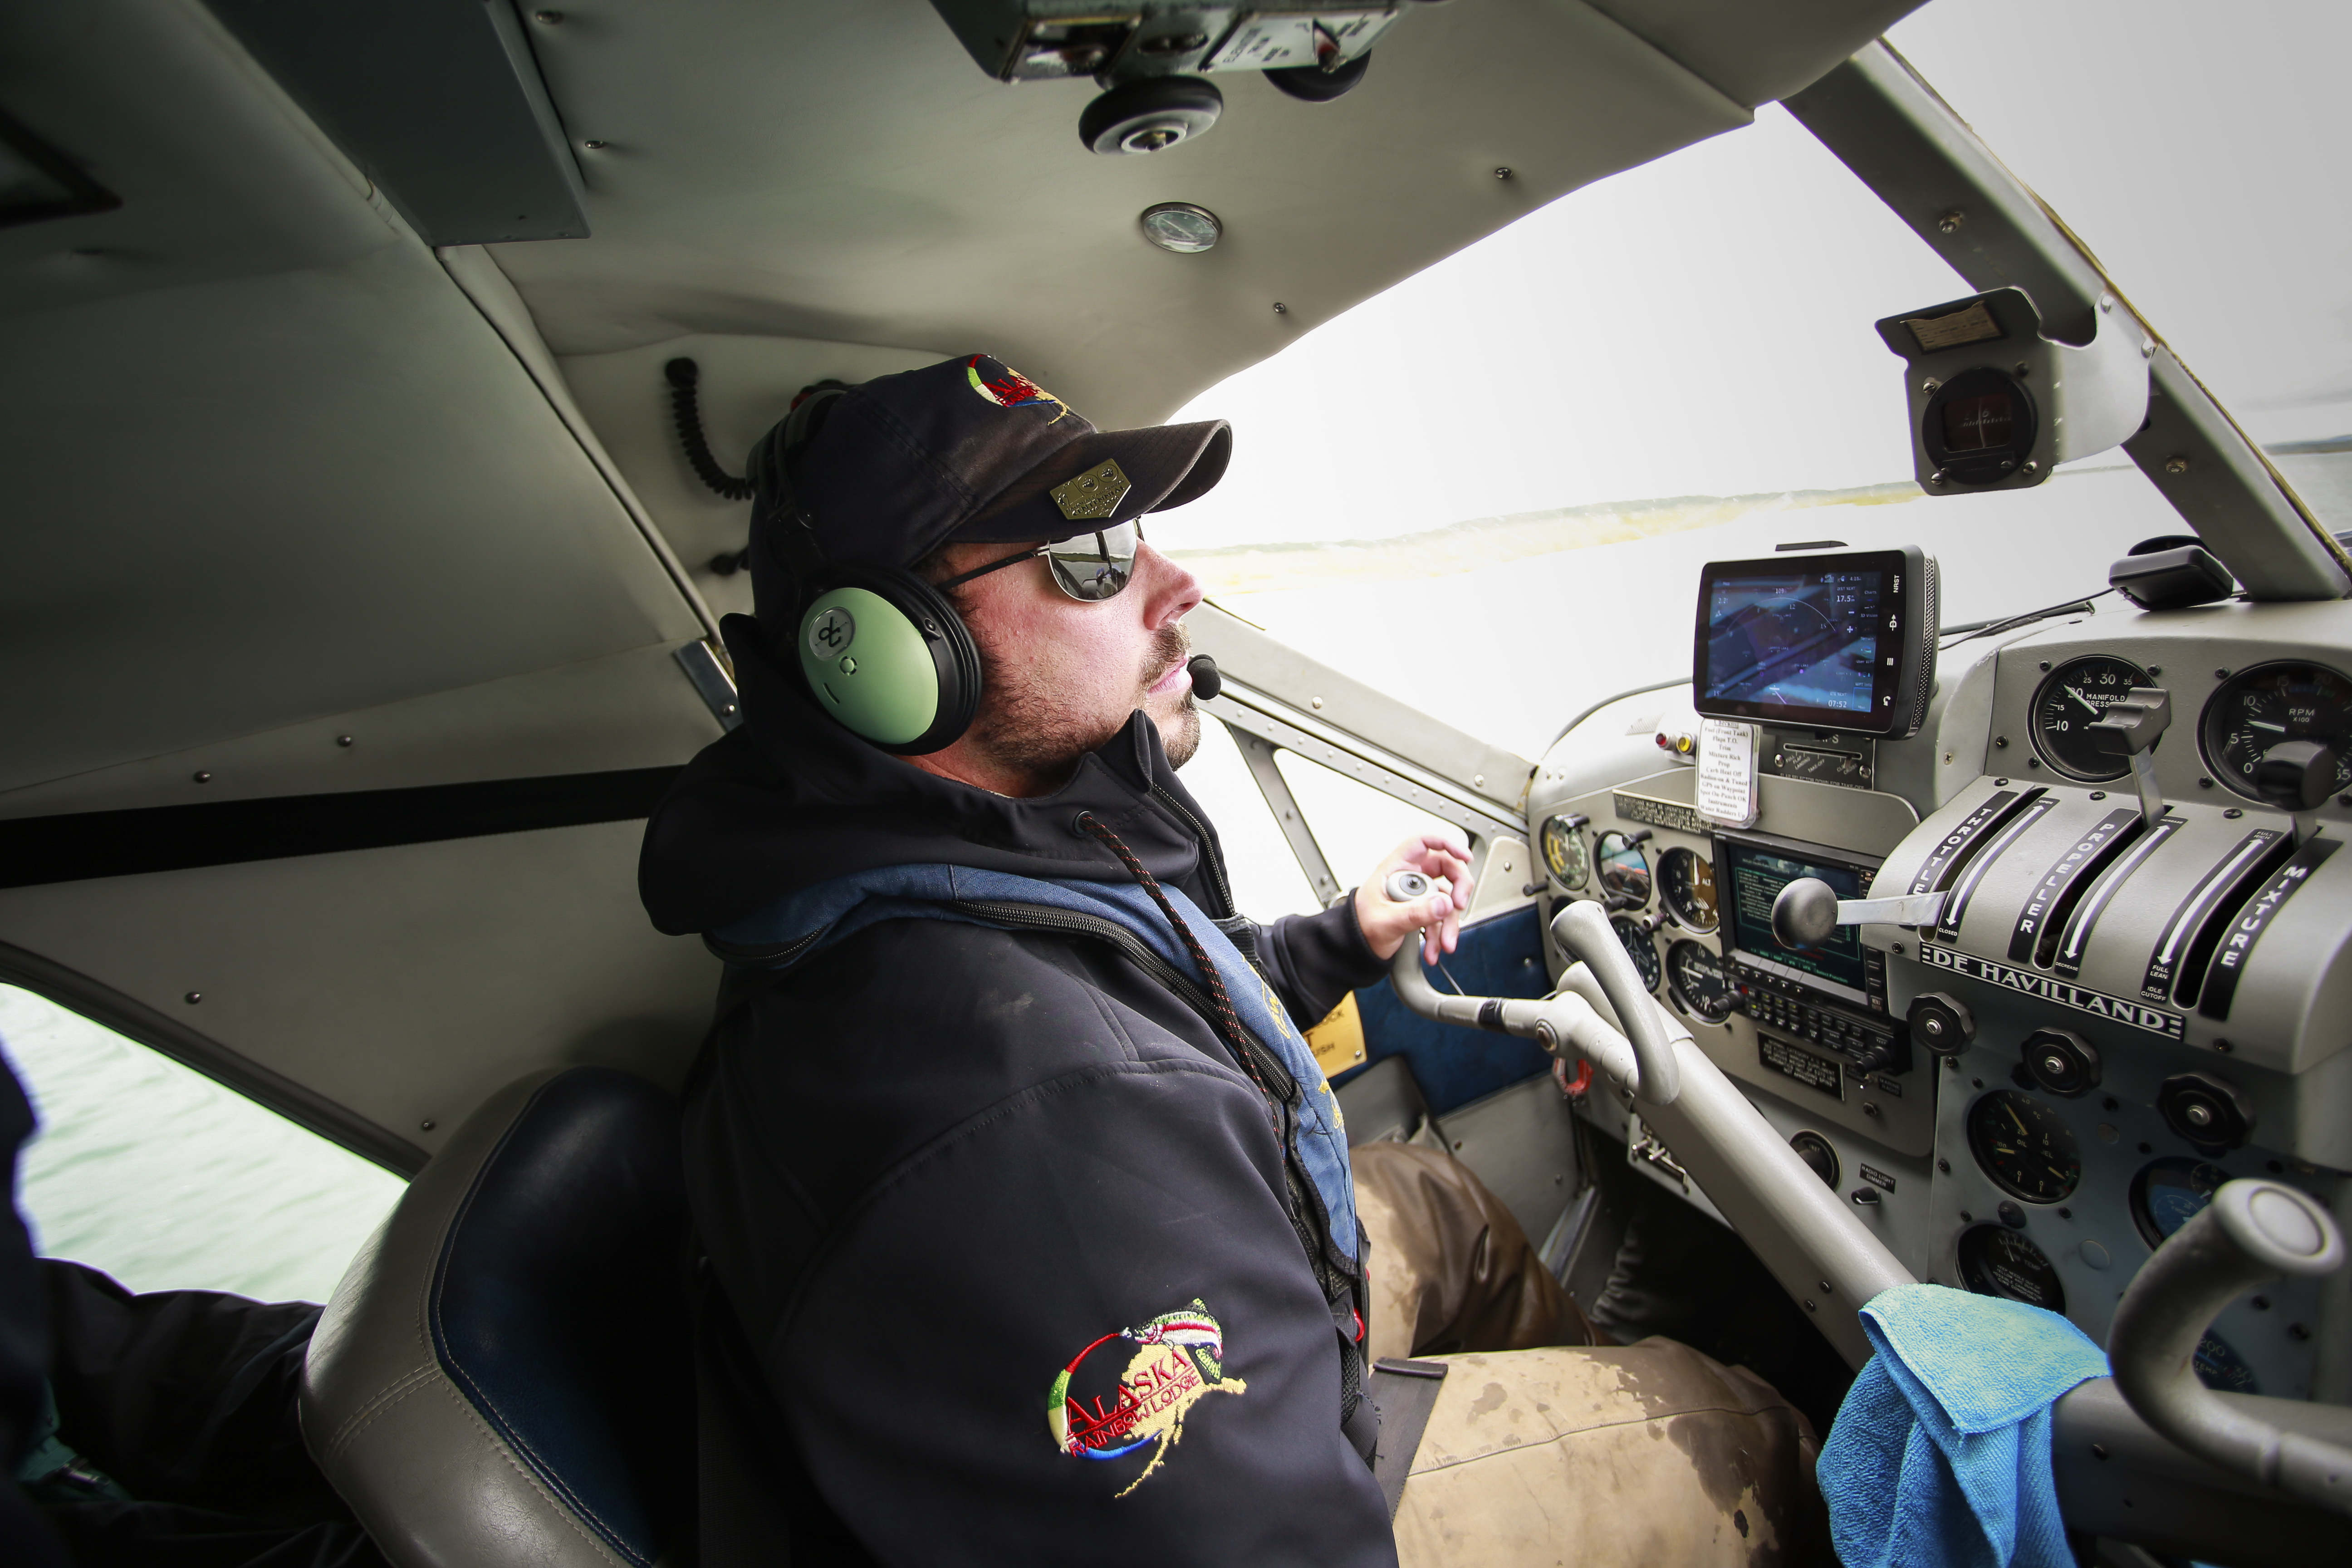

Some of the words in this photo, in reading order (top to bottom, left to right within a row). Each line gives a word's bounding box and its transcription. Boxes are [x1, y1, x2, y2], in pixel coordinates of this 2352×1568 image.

[1982, 407, 1990, 418] 6
[1072, 485, 1126, 516] CENTENNIAL
[2099, 673, 2115, 685] 30
[2277, 676, 2289, 687] 15
[2313, 674, 2332, 686] 20
[2086, 693, 2125, 702] MANIFOLD
[2243, 695, 2256, 706] 10
[1828, 699, 1847, 708] 07:52
[2288, 708, 2315, 717] RPM
[2056, 720, 2068, 731] 10
[1715, 727, 1732, 735] (Front
[1733, 729, 1749, 738] Tank)
[1713, 735, 1726, 744] Flaps
[2230, 733, 2239, 745] 5
[1709, 750, 1728, 760] Mixture
[1718, 760, 1730, 769] Prop
[1795, 756, 1811, 771] LANDING
[2243, 762, 2254, 774] 0
[1720, 768, 1732, 776] Heat
[1702, 781, 1713, 789] GPS
[1721, 784, 1746, 794] Waypoint
[1731, 778, 1748, 786] Tuned
[1700, 788, 1711, 796] Spot
[1708, 798, 1738, 809] Instruments
[1700, 804, 1715, 812] Water
[1716, 808, 1737, 817] Rudders
[1738, 811, 1746, 820] Up
[1913, 808, 1993, 896] THROTTLE
[1701, 877, 1711, 887] ALT
[2020, 823, 2116, 934] PROPELLER
[2220, 864, 2308, 967] MIXTURE
[1938, 928, 1958, 937] CLOSED
[2055, 960, 2079, 972] DECREASE
[2152, 965, 2169, 973] FULL
[1816, 969, 1829, 977] Select
[1829, 973, 1848, 983] Function
[2149, 971, 2168, 980] LEAN
[1933, 951, 1968, 973] DE
[1980, 963, 2165, 1029] HAVILLAND
[2147, 986, 2162, 995] IDLE
[2141, 991, 2166, 1001] CUTOFF
[1313, 1041, 1336, 1058] USH
[1879, 1078, 1900, 1089] MARINE
[1881, 1085, 1899, 1095] RADIO
[2017, 1139, 2027, 1148] OIL
[1861, 1165, 1878, 1176] RADIO
[1878, 1171, 1894, 1185] LIGHT
[1866, 1173, 1886, 1187] DIMMER
[2024, 1259, 2041, 1270] TEMP
[2009, 1270, 2024, 1281] NEEDLE
[1997, 1269, 2013, 1279] YELLOW
[2024, 1284, 2040, 1294] DURING
[2011, 1284, 2037, 1302] CONDITIONS
[2014, 1283, 2043, 1301] CARBURETOR
[2195, 1360, 2218, 1375] TEMP
[1066, 1349, 1194, 1436] ALASKA
[1068, 1404, 1151, 1457] RAINBOW
[1151, 1368, 1201, 1412] LODGE
